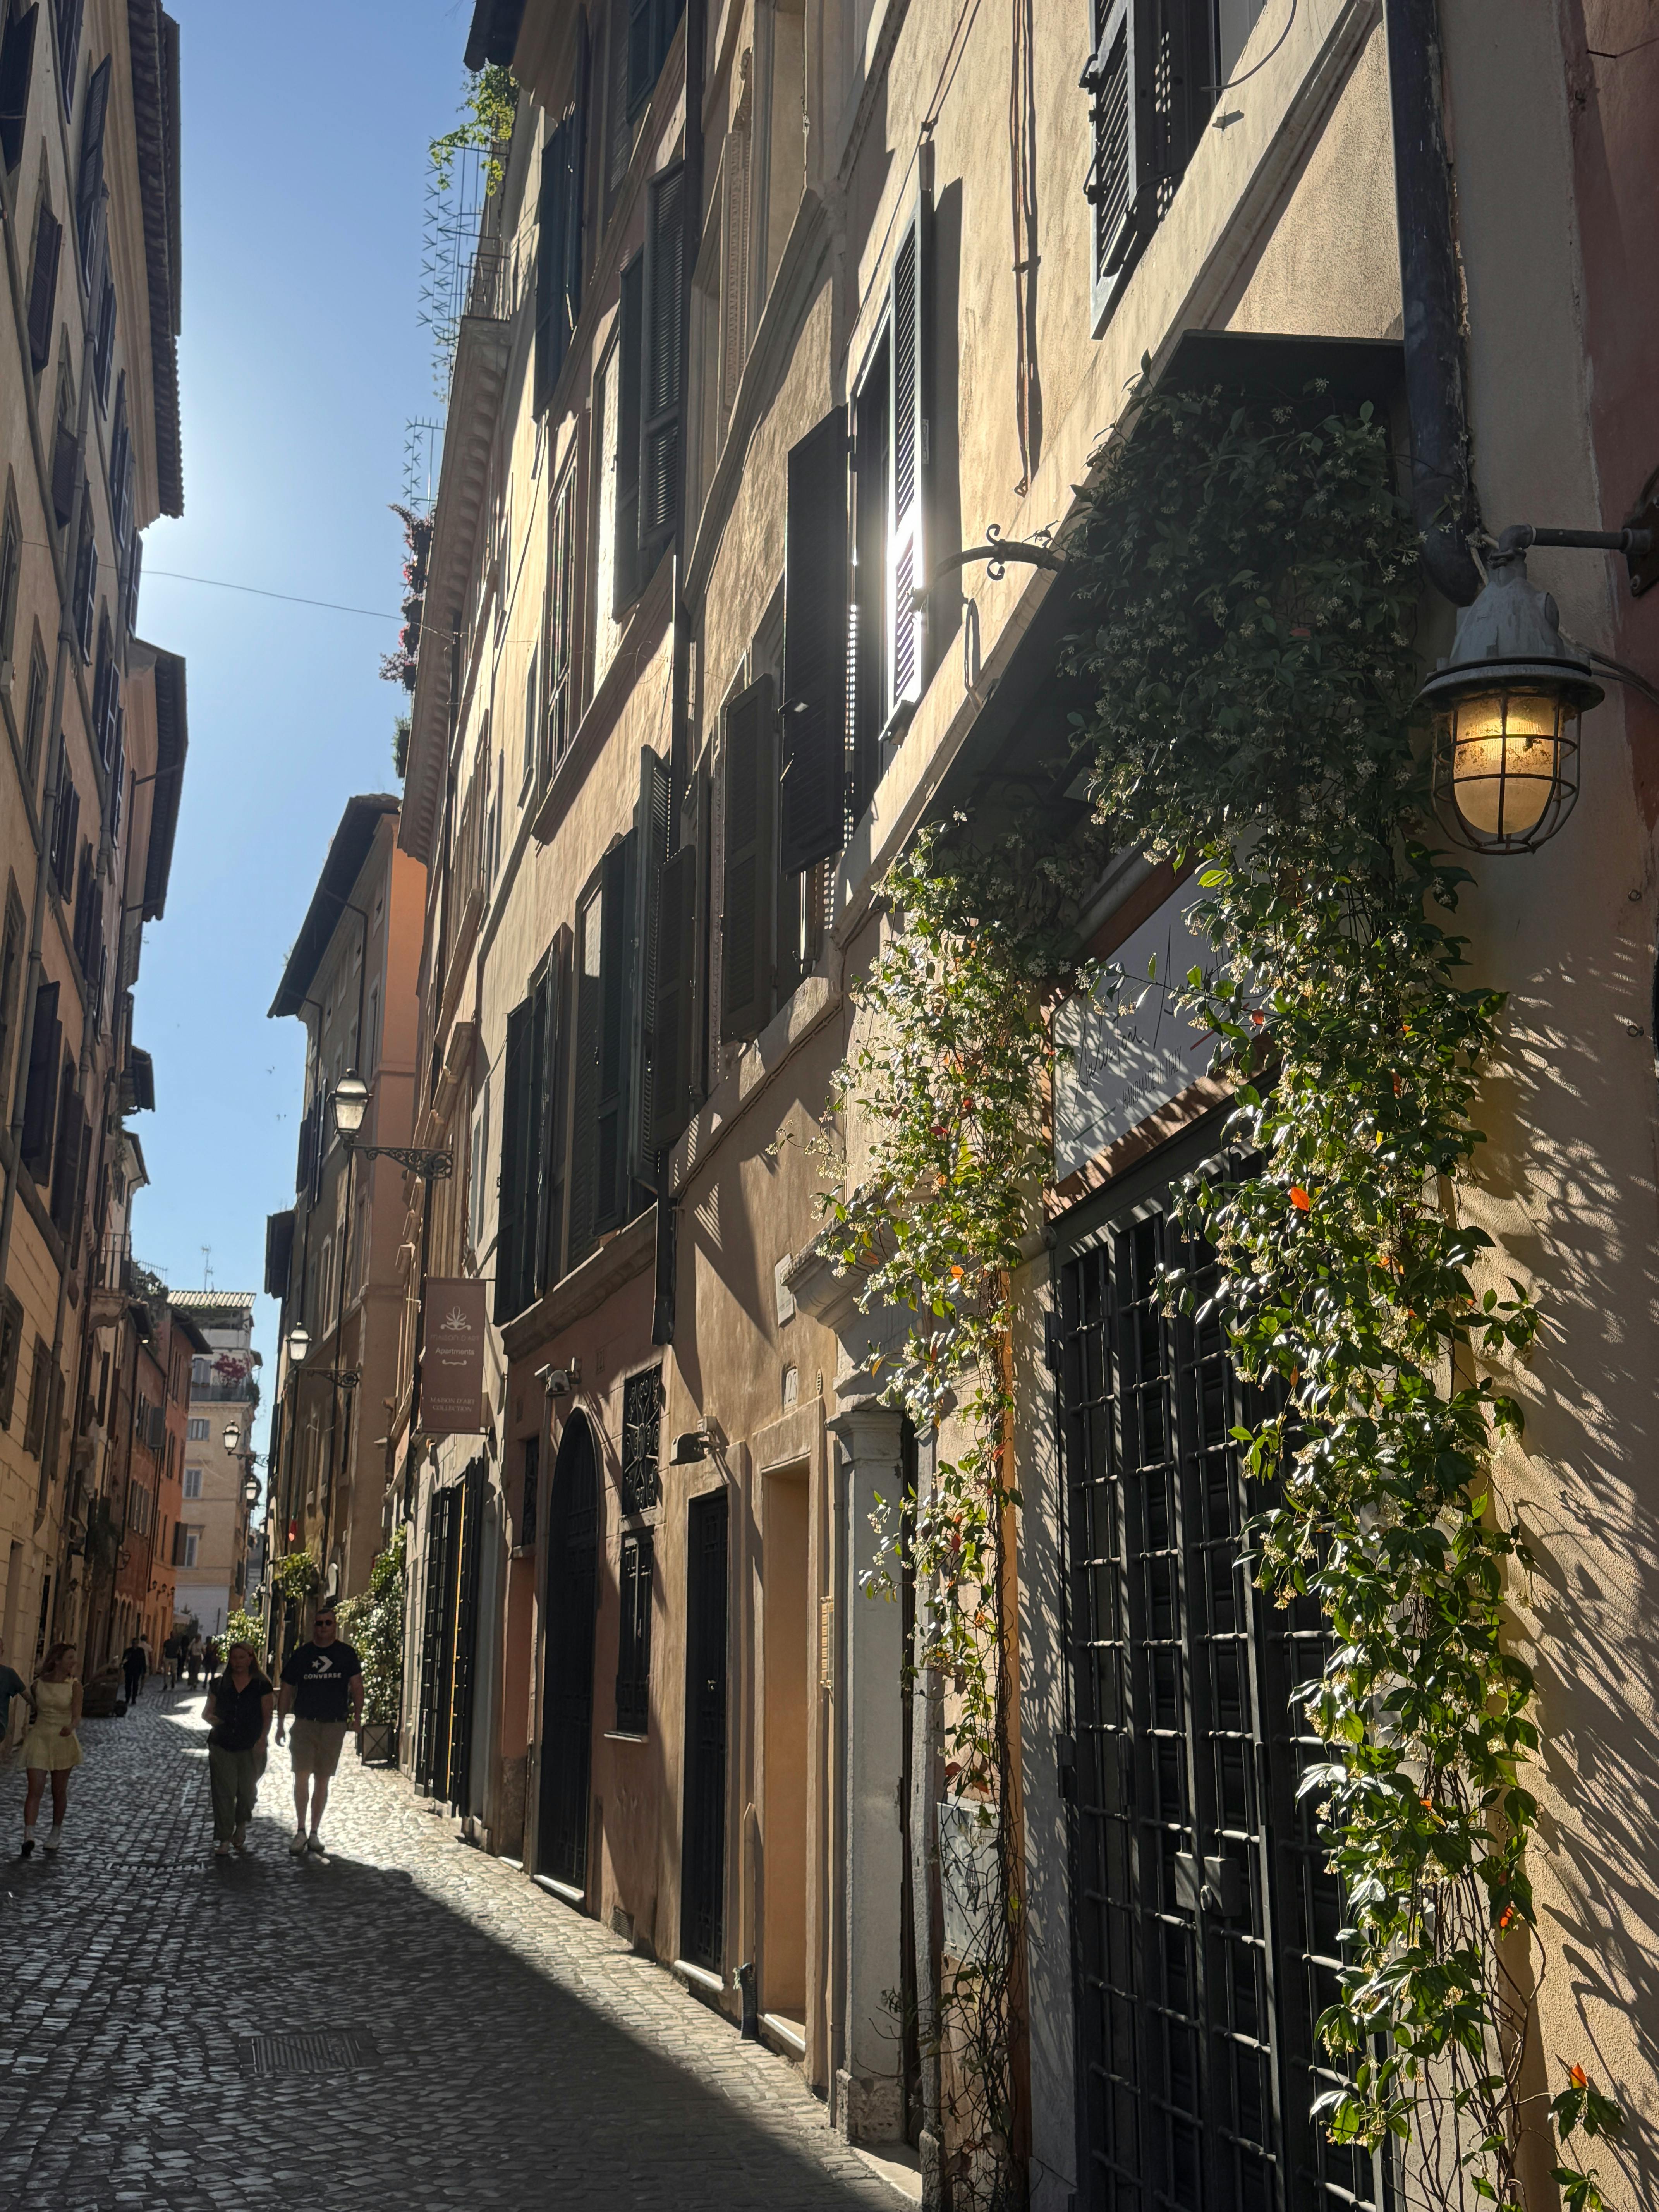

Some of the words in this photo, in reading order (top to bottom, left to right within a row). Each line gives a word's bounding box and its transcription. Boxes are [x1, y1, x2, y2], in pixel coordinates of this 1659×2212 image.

[1123, 1067, 1156, 1112] HANDMADE
[1157, 1060, 1164, 1085] IN
[1166, 1046, 1181, 1080] ITALY
[435, 1347, 475, 1355] Apartments
